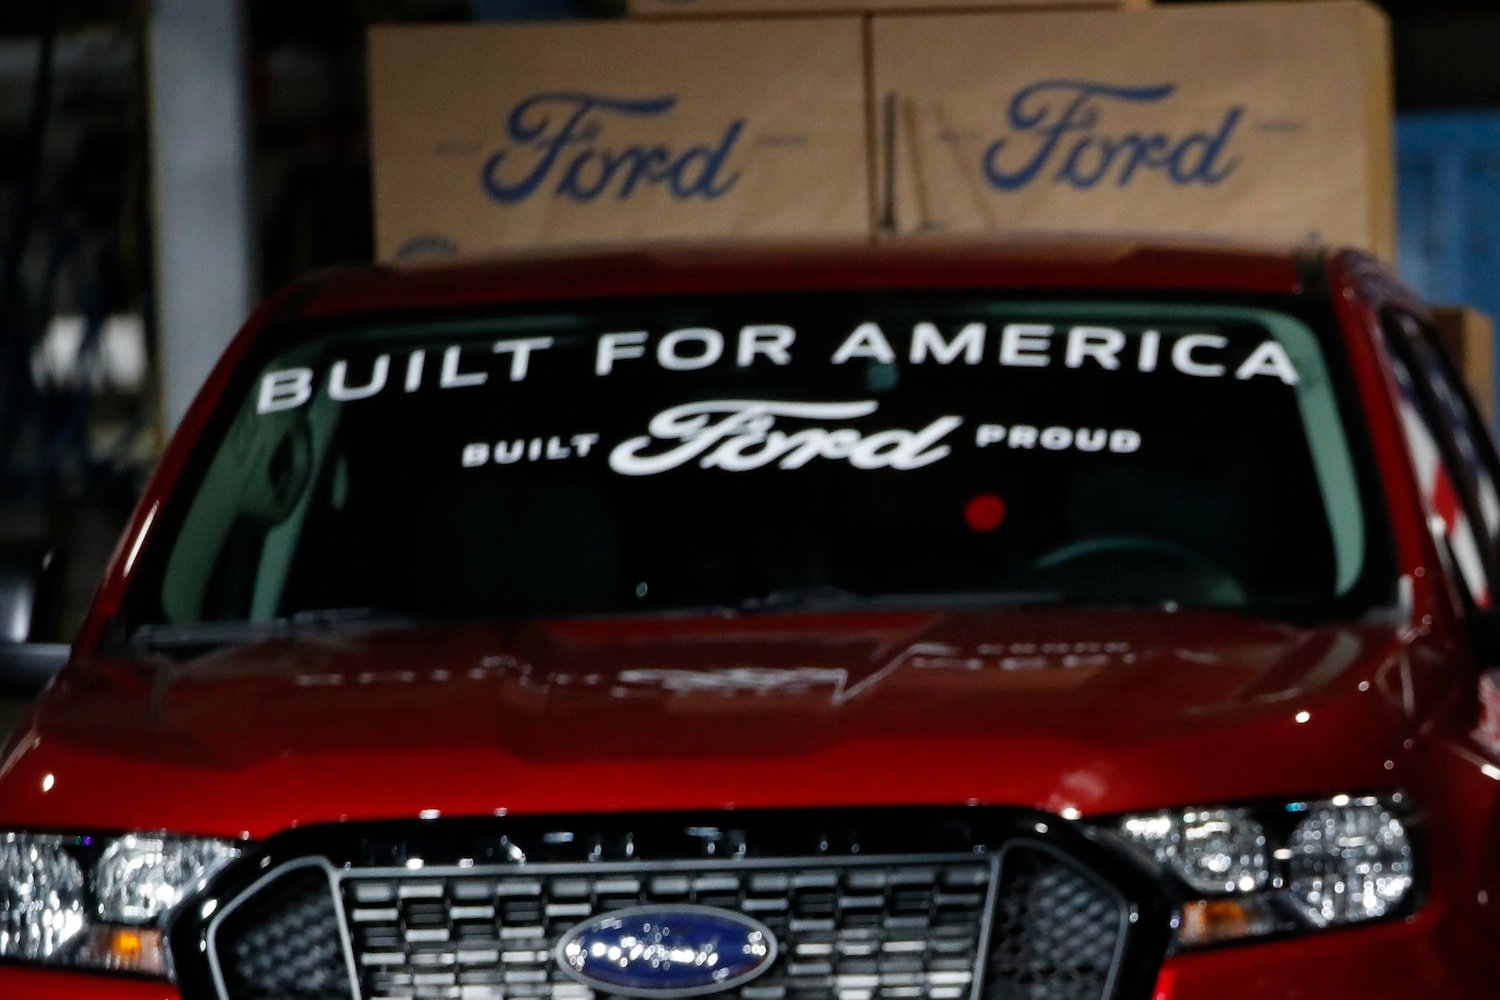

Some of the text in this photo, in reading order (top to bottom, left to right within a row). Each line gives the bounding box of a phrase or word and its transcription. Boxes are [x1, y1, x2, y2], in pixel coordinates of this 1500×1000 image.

[481, 91, 745, 205] Ford
[982, 79, 1243, 191] Ford
[256, 321, 1302, 415] BUILT FOR AMERICA
[461, 398, 1143, 477] BUILT Ford PROUD
